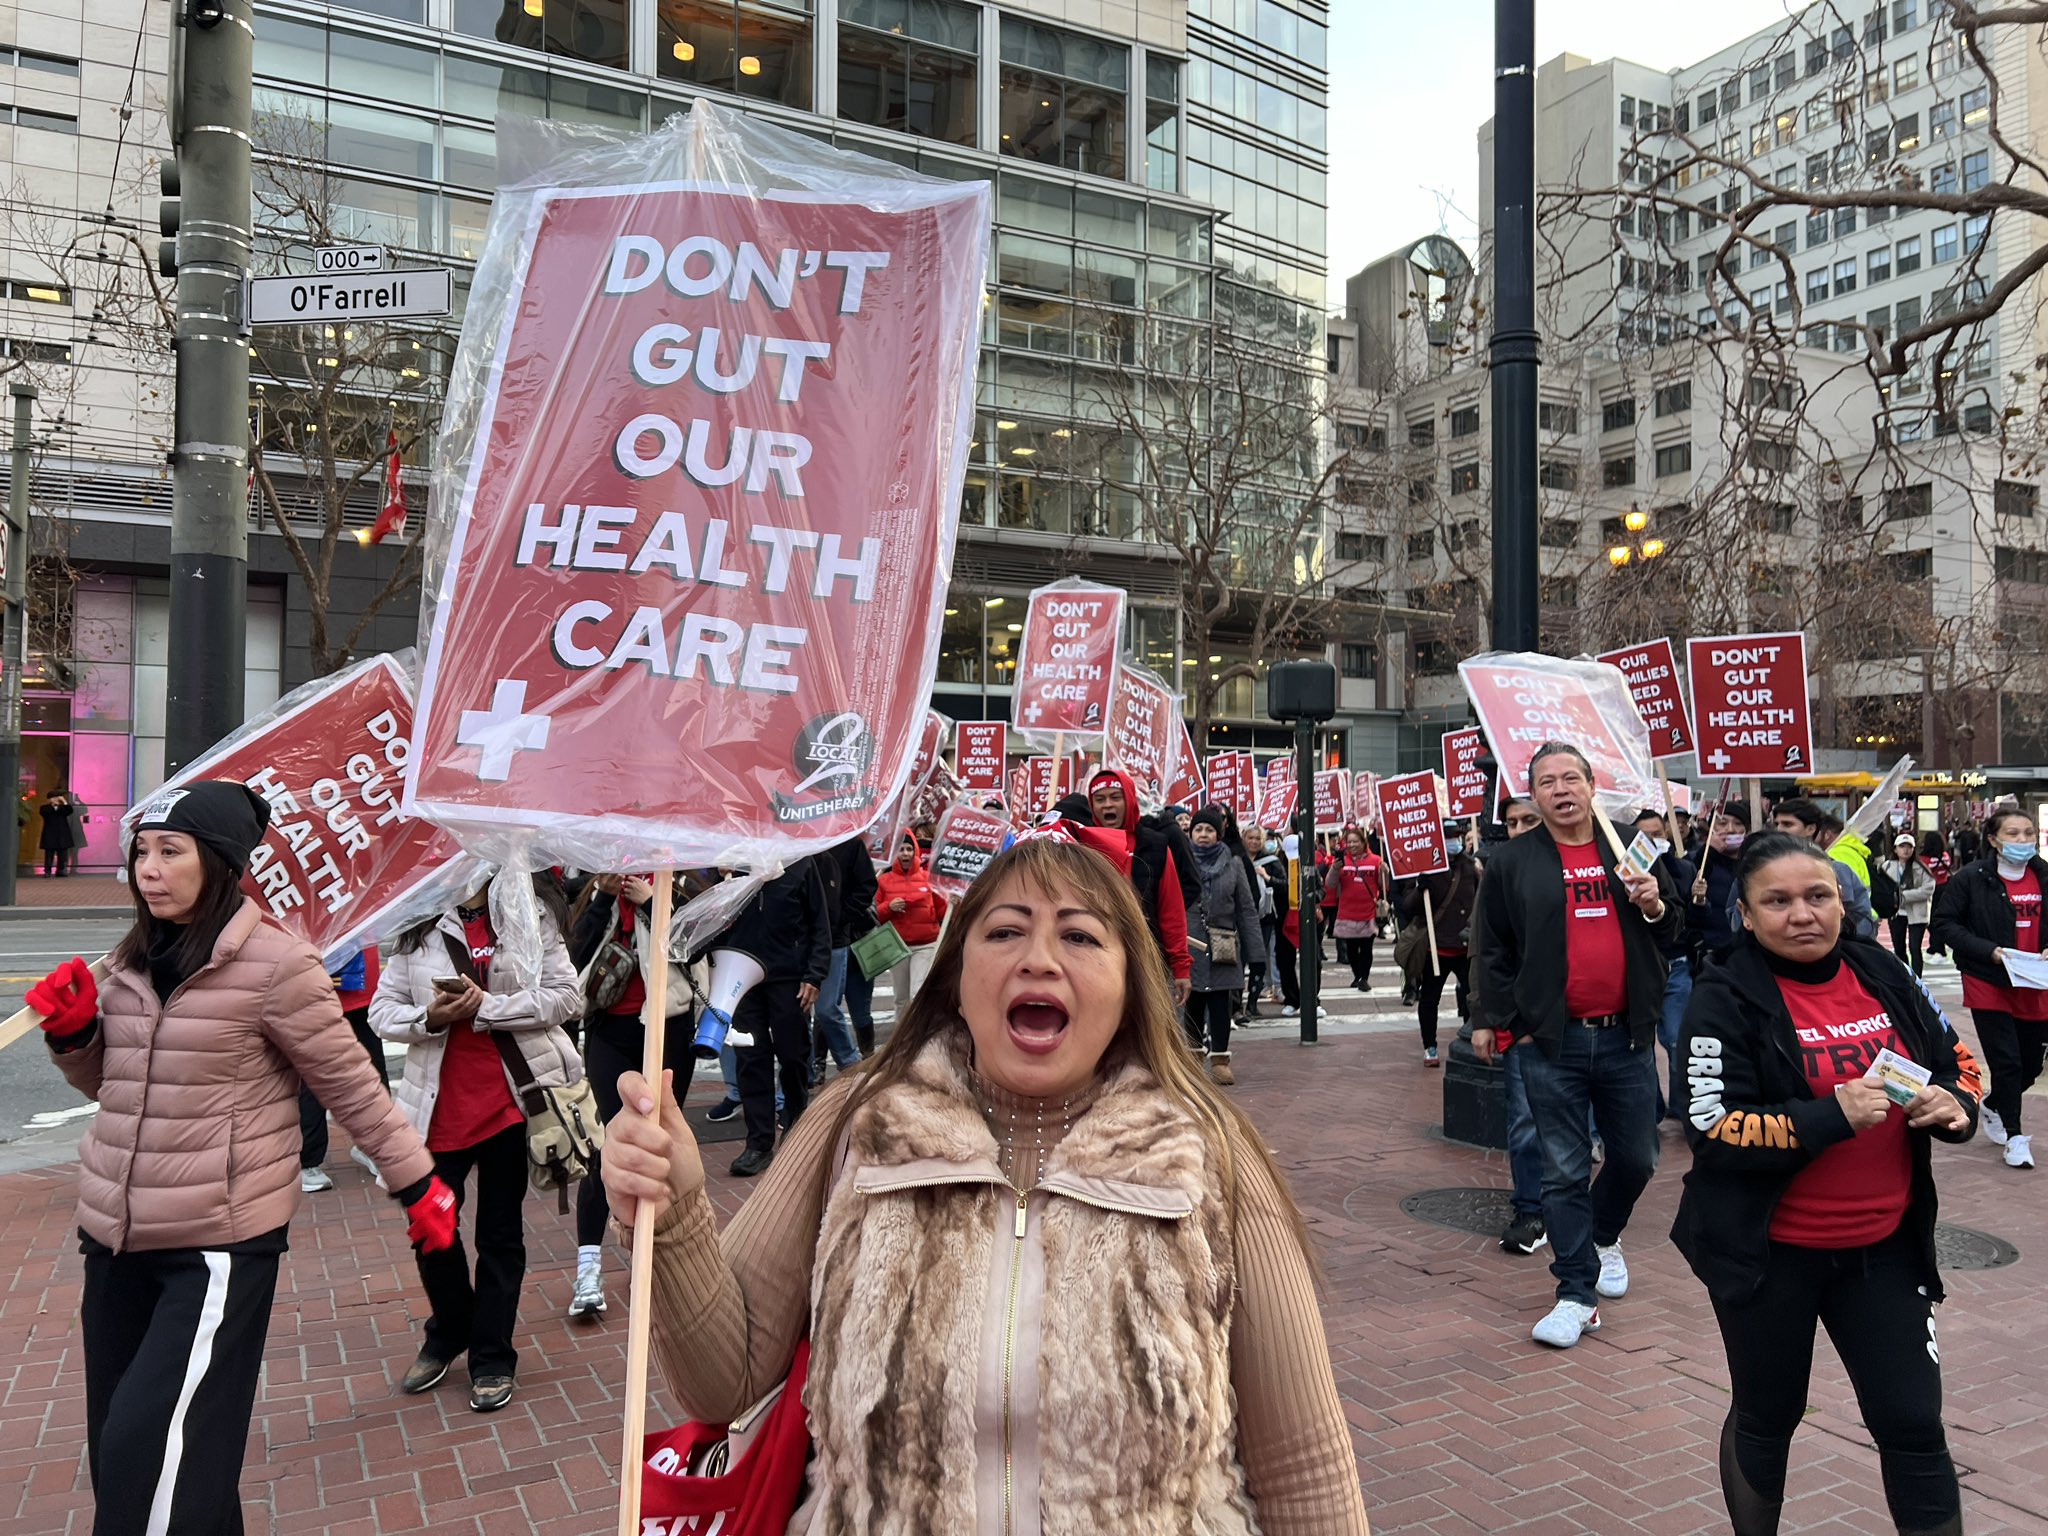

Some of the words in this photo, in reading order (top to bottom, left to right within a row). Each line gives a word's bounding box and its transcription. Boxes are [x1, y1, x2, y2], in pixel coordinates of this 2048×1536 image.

[322, 251, 360, 269] 000
[605, 235, 890, 314] DON'T
[291, 281, 406, 312] O'Farrell
[632, 324, 830, 402] GUT
[616, 413, 812, 497] OUR
[516, 503, 882, 600] HEALTH
[1047, 602, 1102, 618] DON'T
[1053, 623, 1090, 638] GUT
[555, 600, 808, 693] CARE
[1050, 643, 1088, 659] OUR
[1620, 652, 1649, 670] OUR
[1711, 646, 1781, 666] DON'T
[1033, 664, 1100, 680] HEALTH
[1624, 665, 1669, 684] MILIES
[1724, 668, 1771, 686] GUT
[1041, 684, 1088, 700] CARE
[1122, 679, 1160, 709] DON'T
[1492, 675, 1565, 696] DON'T
[1633, 684, 1660, 700] EED
[1514, 692, 1562, 710] GUT
[1726, 688, 1773, 706] OUR
[1127, 700, 1153, 721] GUT
[1638, 698, 1674, 716] ALTH
[1523, 710, 1574, 727] OUR
[1708, 708, 1794, 728] HEALTH
[966, 727, 996, 736] DON'T
[1126, 718, 1152, 738] OUR
[971, 737, 992, 746] GUT
[1114, 727, 1160, 761] HEALTH
[1508, 727, 1606, 749] HEALTH
[1724, 730, 1782, 746] CARE
[809, 745, 859, 762] LOCAL
[971, 747, 991, 756] OUR
[1458, 748, 1478, 760] GUT
[962, 758, 999, 766] HEALTH
[1119, 748, 1152, 774] CARE
[1216, 758, 1229, 769] OUR
[1459, 762, 1475, 772] OU
[968, 768, 993, 776] CARE
[1210, 767, 1236, 780] FAMILIES
[346, 754, 407, 828] GUT
[1110, 780, 1122, 788] JO
[1214, 778, 1230, 789] NEED
[1397, 782, 1420, 796] OUR
[1459, 785, 1484, 798] CARE
[1210, 788, 1234, 800] HEALTH
[1385, 792, 1434, 812] FAMILIES
[780, 796, 865, 820] UNITEHERE!
[1398, 808, 1427, 824] NEED
[311, 778, 370, 860] OUR
[952, 818, 1001, 834] RESPECT
[947, 830, 964, 839] OUR
[1393, 821, 1436, 840] HEALTH
[245, 766, 354, 914] HEALTH
[1404, 836, 1432, 852] CARE
[938, 858, 958, 868] OUR
[942, 846, 992, 863] RESPECT
[249, 844, 305, 919] ARE
[730, 980, 742, 998] PYLE
[1825, 1012, 1892, 1038] WORKE
[1688, 1036, 1726, 1132] BRAND
